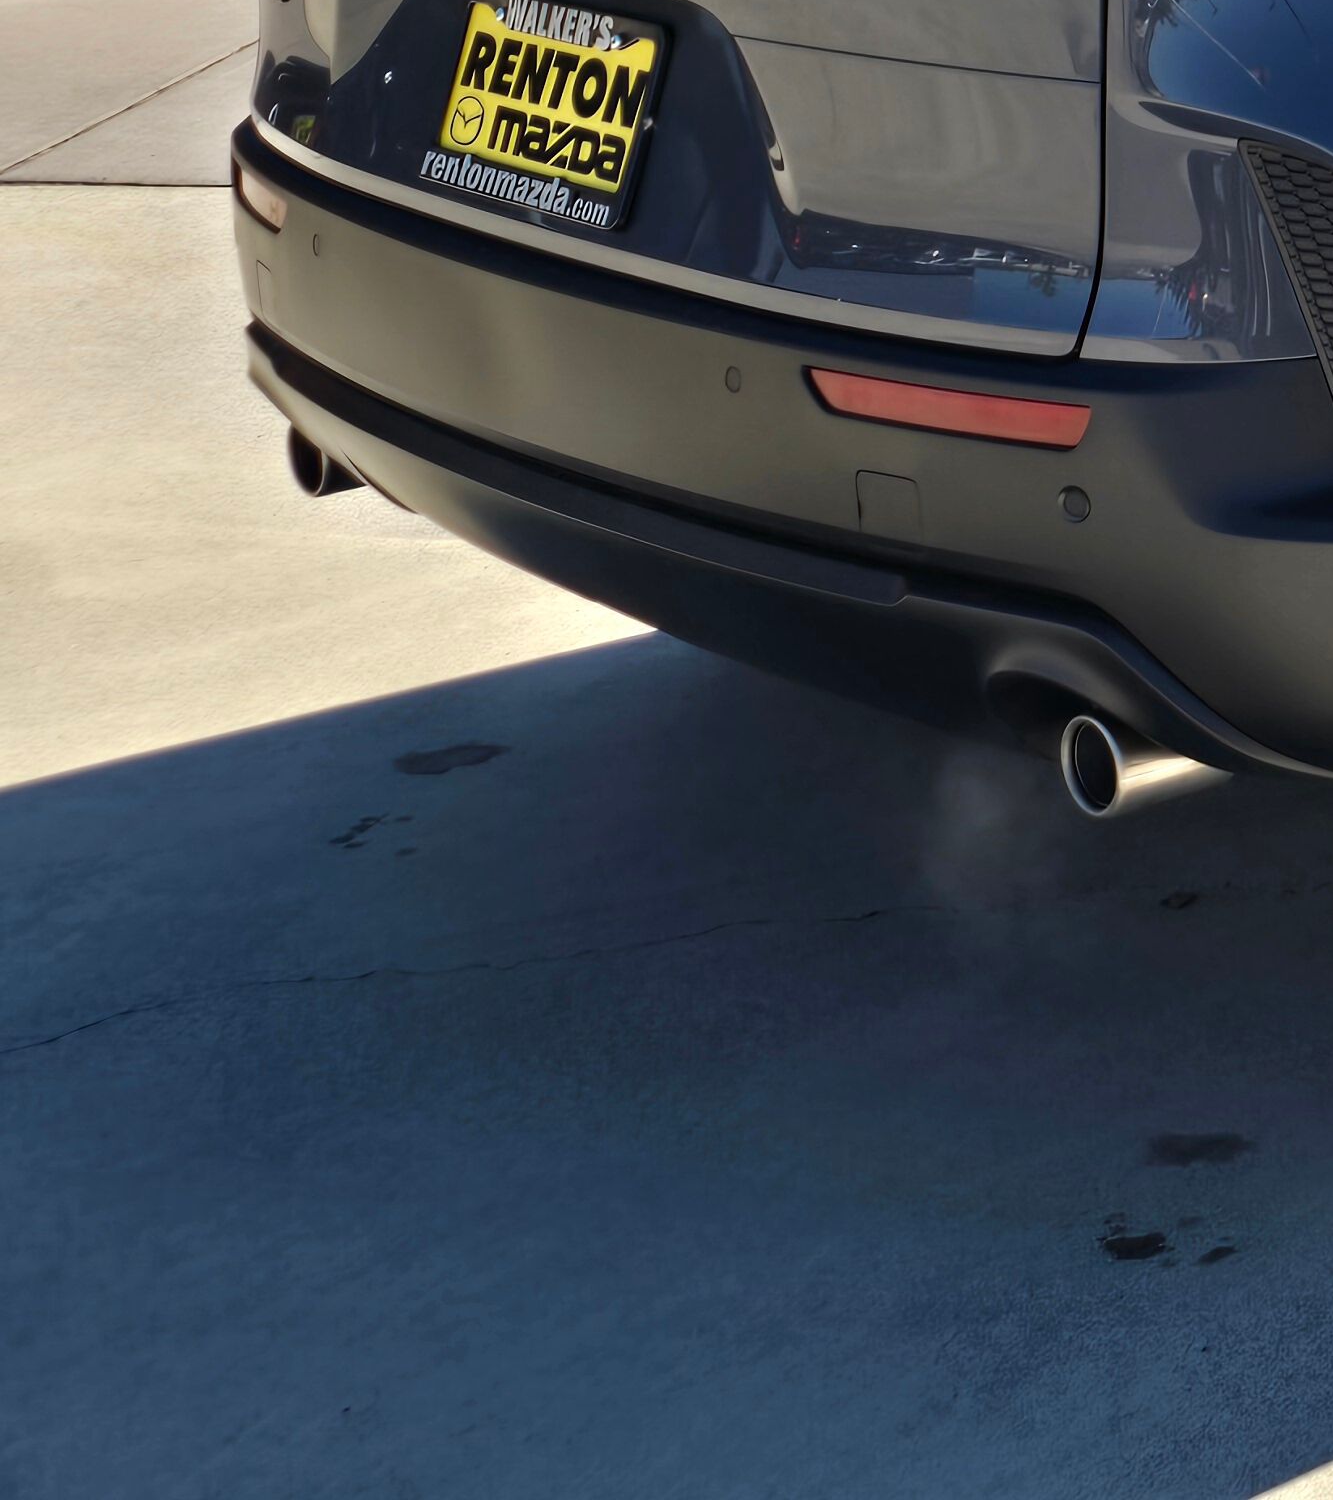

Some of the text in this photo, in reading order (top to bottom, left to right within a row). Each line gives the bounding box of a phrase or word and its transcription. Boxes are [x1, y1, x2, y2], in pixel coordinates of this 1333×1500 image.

[460, 31, 650, 128] RENTON
[487, 105, 626, 184] mazda
[420, 150, 610, 226] rentonmazda.com
